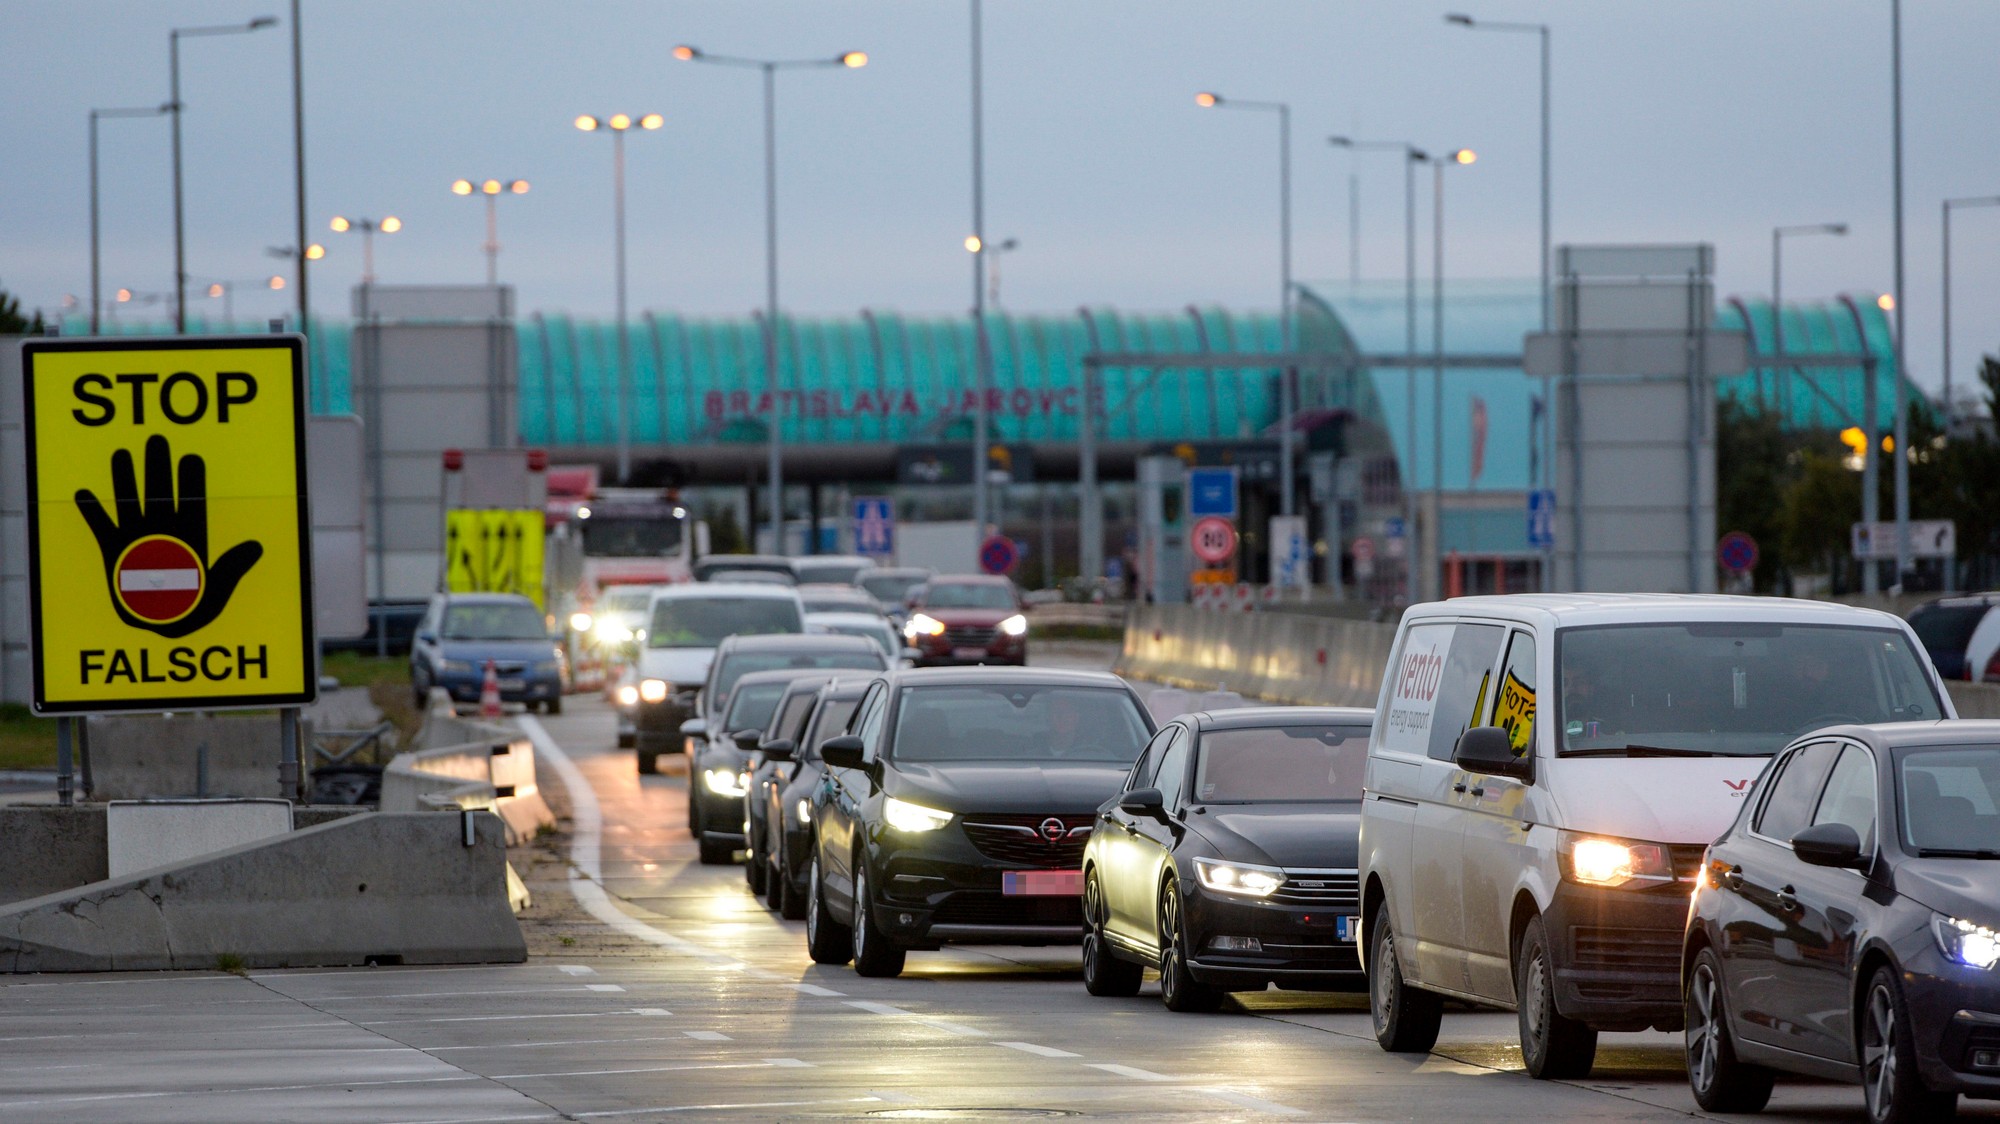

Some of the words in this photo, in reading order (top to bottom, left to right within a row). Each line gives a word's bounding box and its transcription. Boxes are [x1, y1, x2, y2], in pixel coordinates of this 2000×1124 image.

[71, 371, 258, 427] STOP
[705, 388, 919, 419] BRATISLAVA
[79, 644, 268, 685] FALSCH
[1397, 644, 1442, 702] vento
[1390, 709, 1408, 733] energy
[1407, 709, 1430, 735] support
